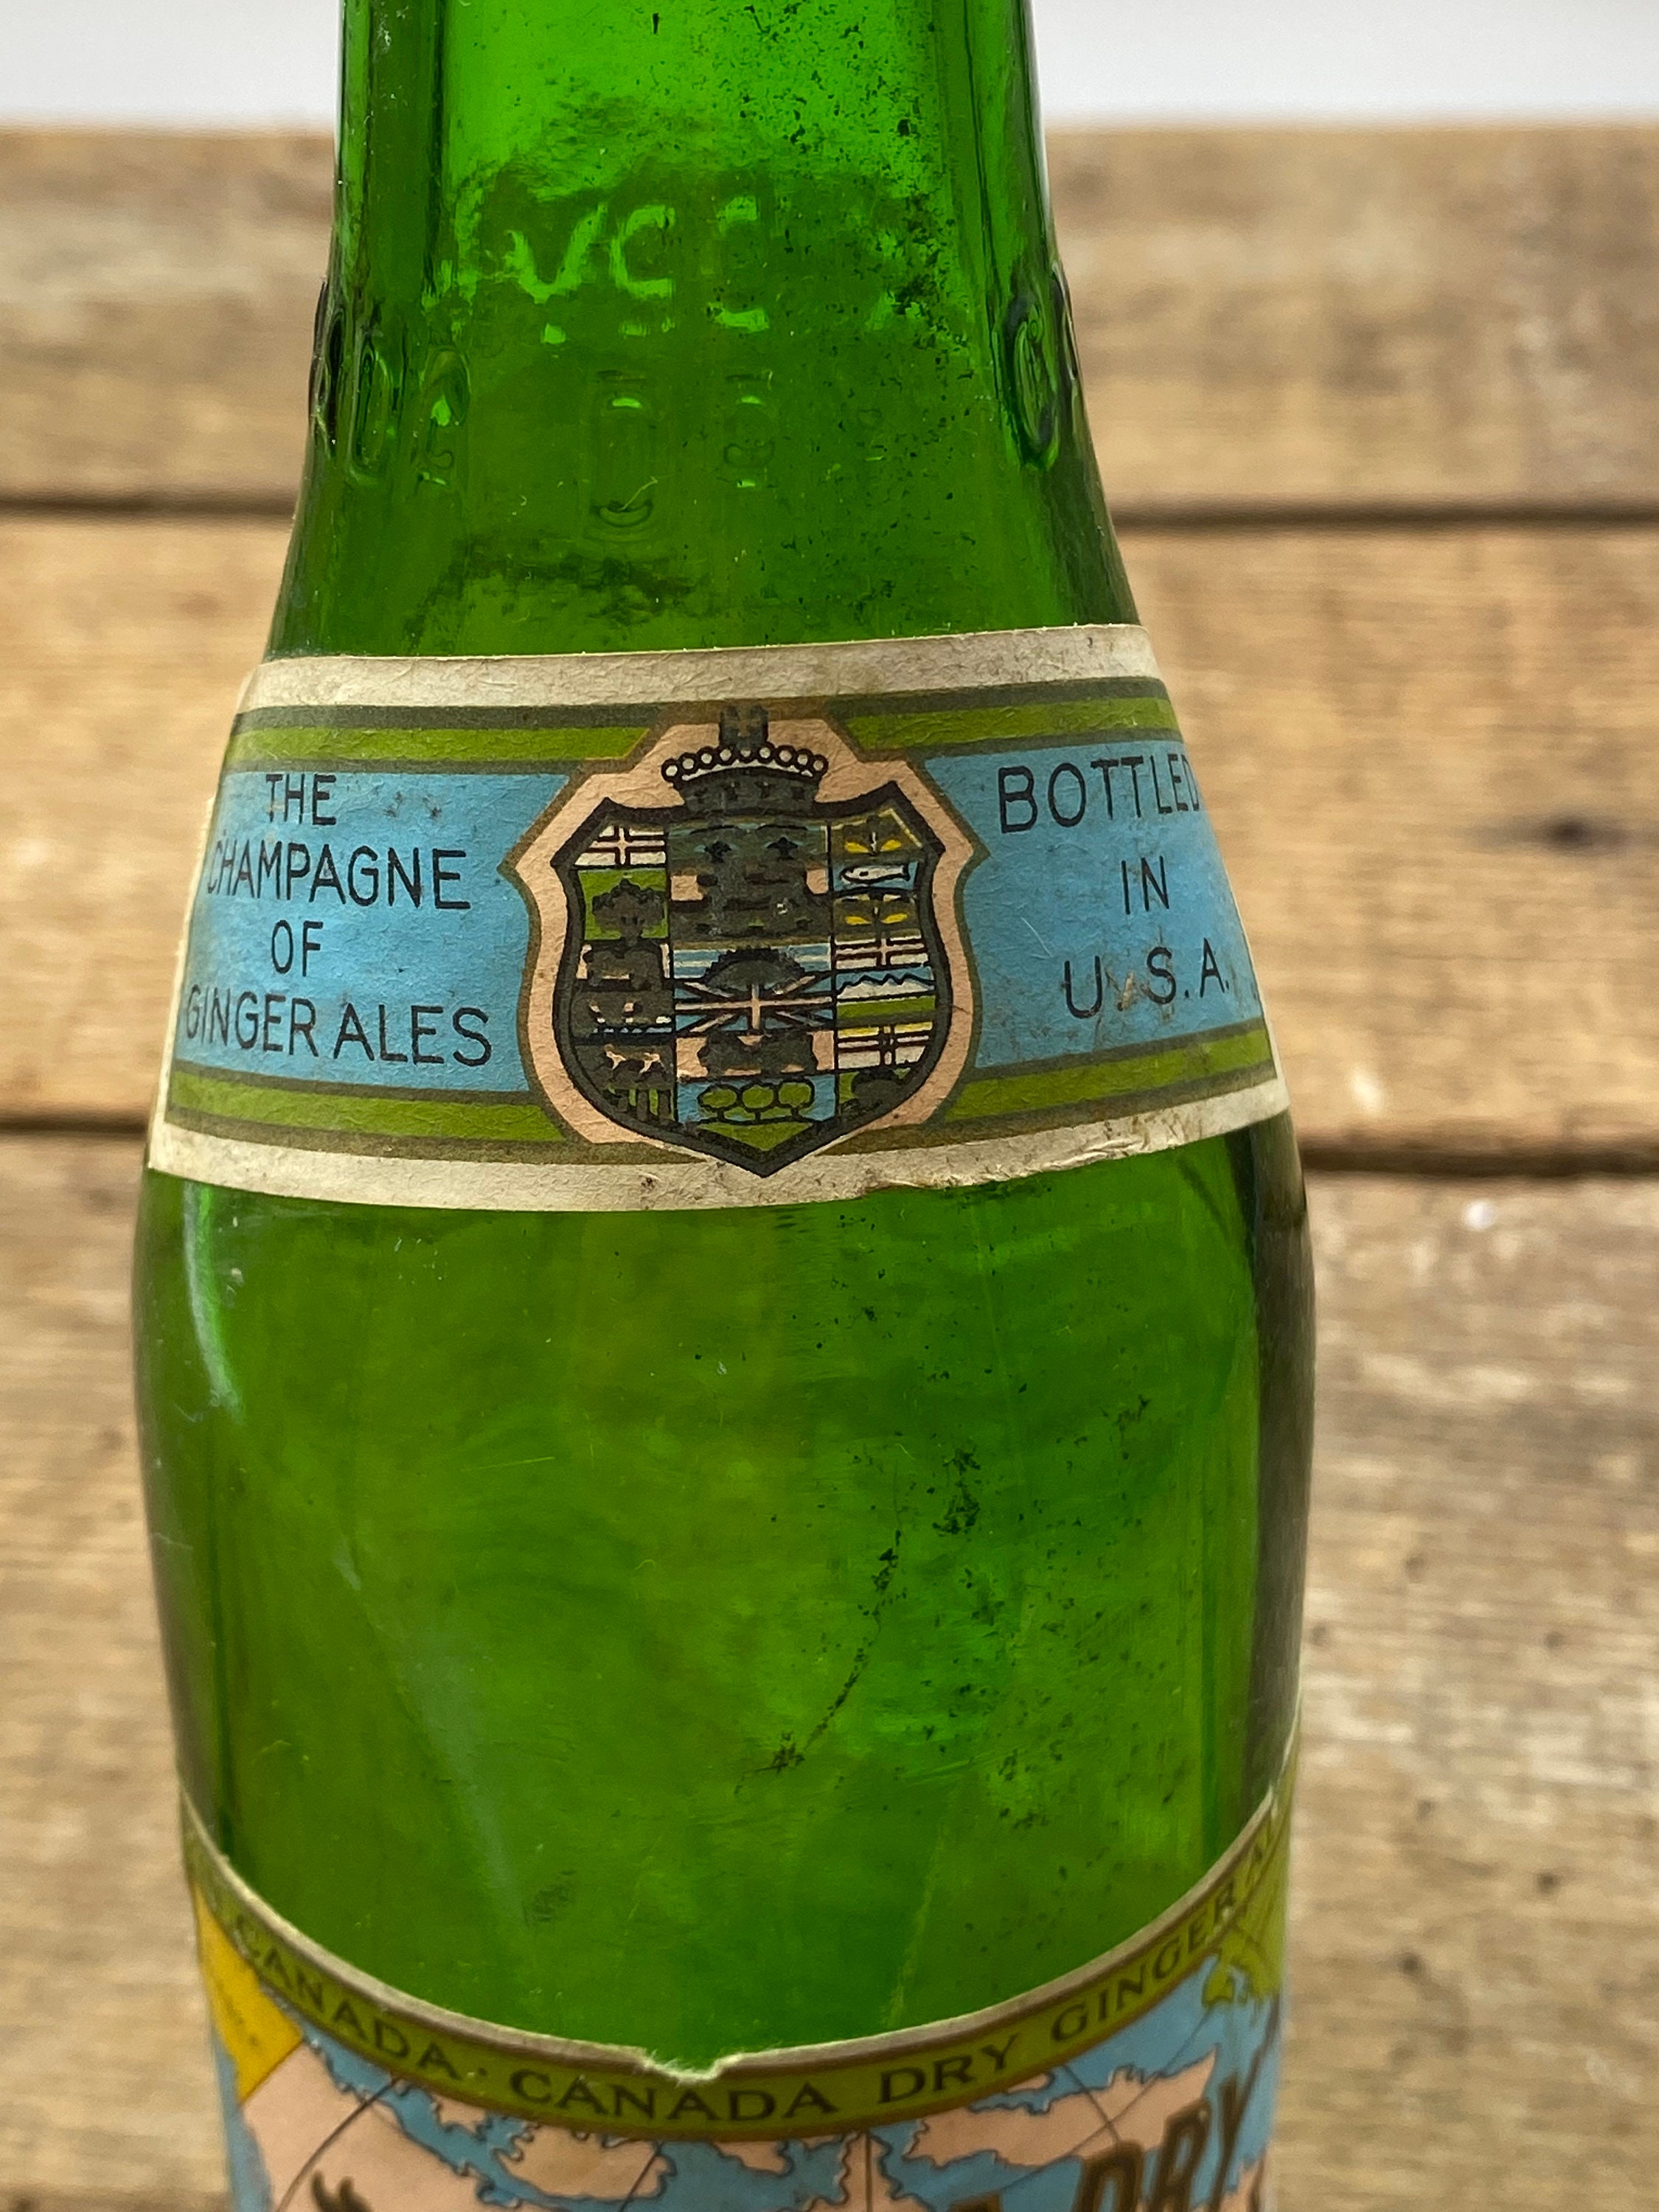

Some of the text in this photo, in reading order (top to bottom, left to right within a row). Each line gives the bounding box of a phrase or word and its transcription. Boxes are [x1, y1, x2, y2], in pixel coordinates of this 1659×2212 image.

[265, 773, 337, 826] THE
[998, 754, 1201, 834] BOTTLED
[207, 838, 471, 910] CHAMPAGNE
[1121, 855, 1169, 915] IN
[271, 919, 324, 977] OF
[185, 984, 493, 1067] GINGER ALES
[508, 2067, 839, 2123] CANADA
[876, 2033, 1019, 2104] DRY
[1050, 1879, 1237, 2044] GINGER
